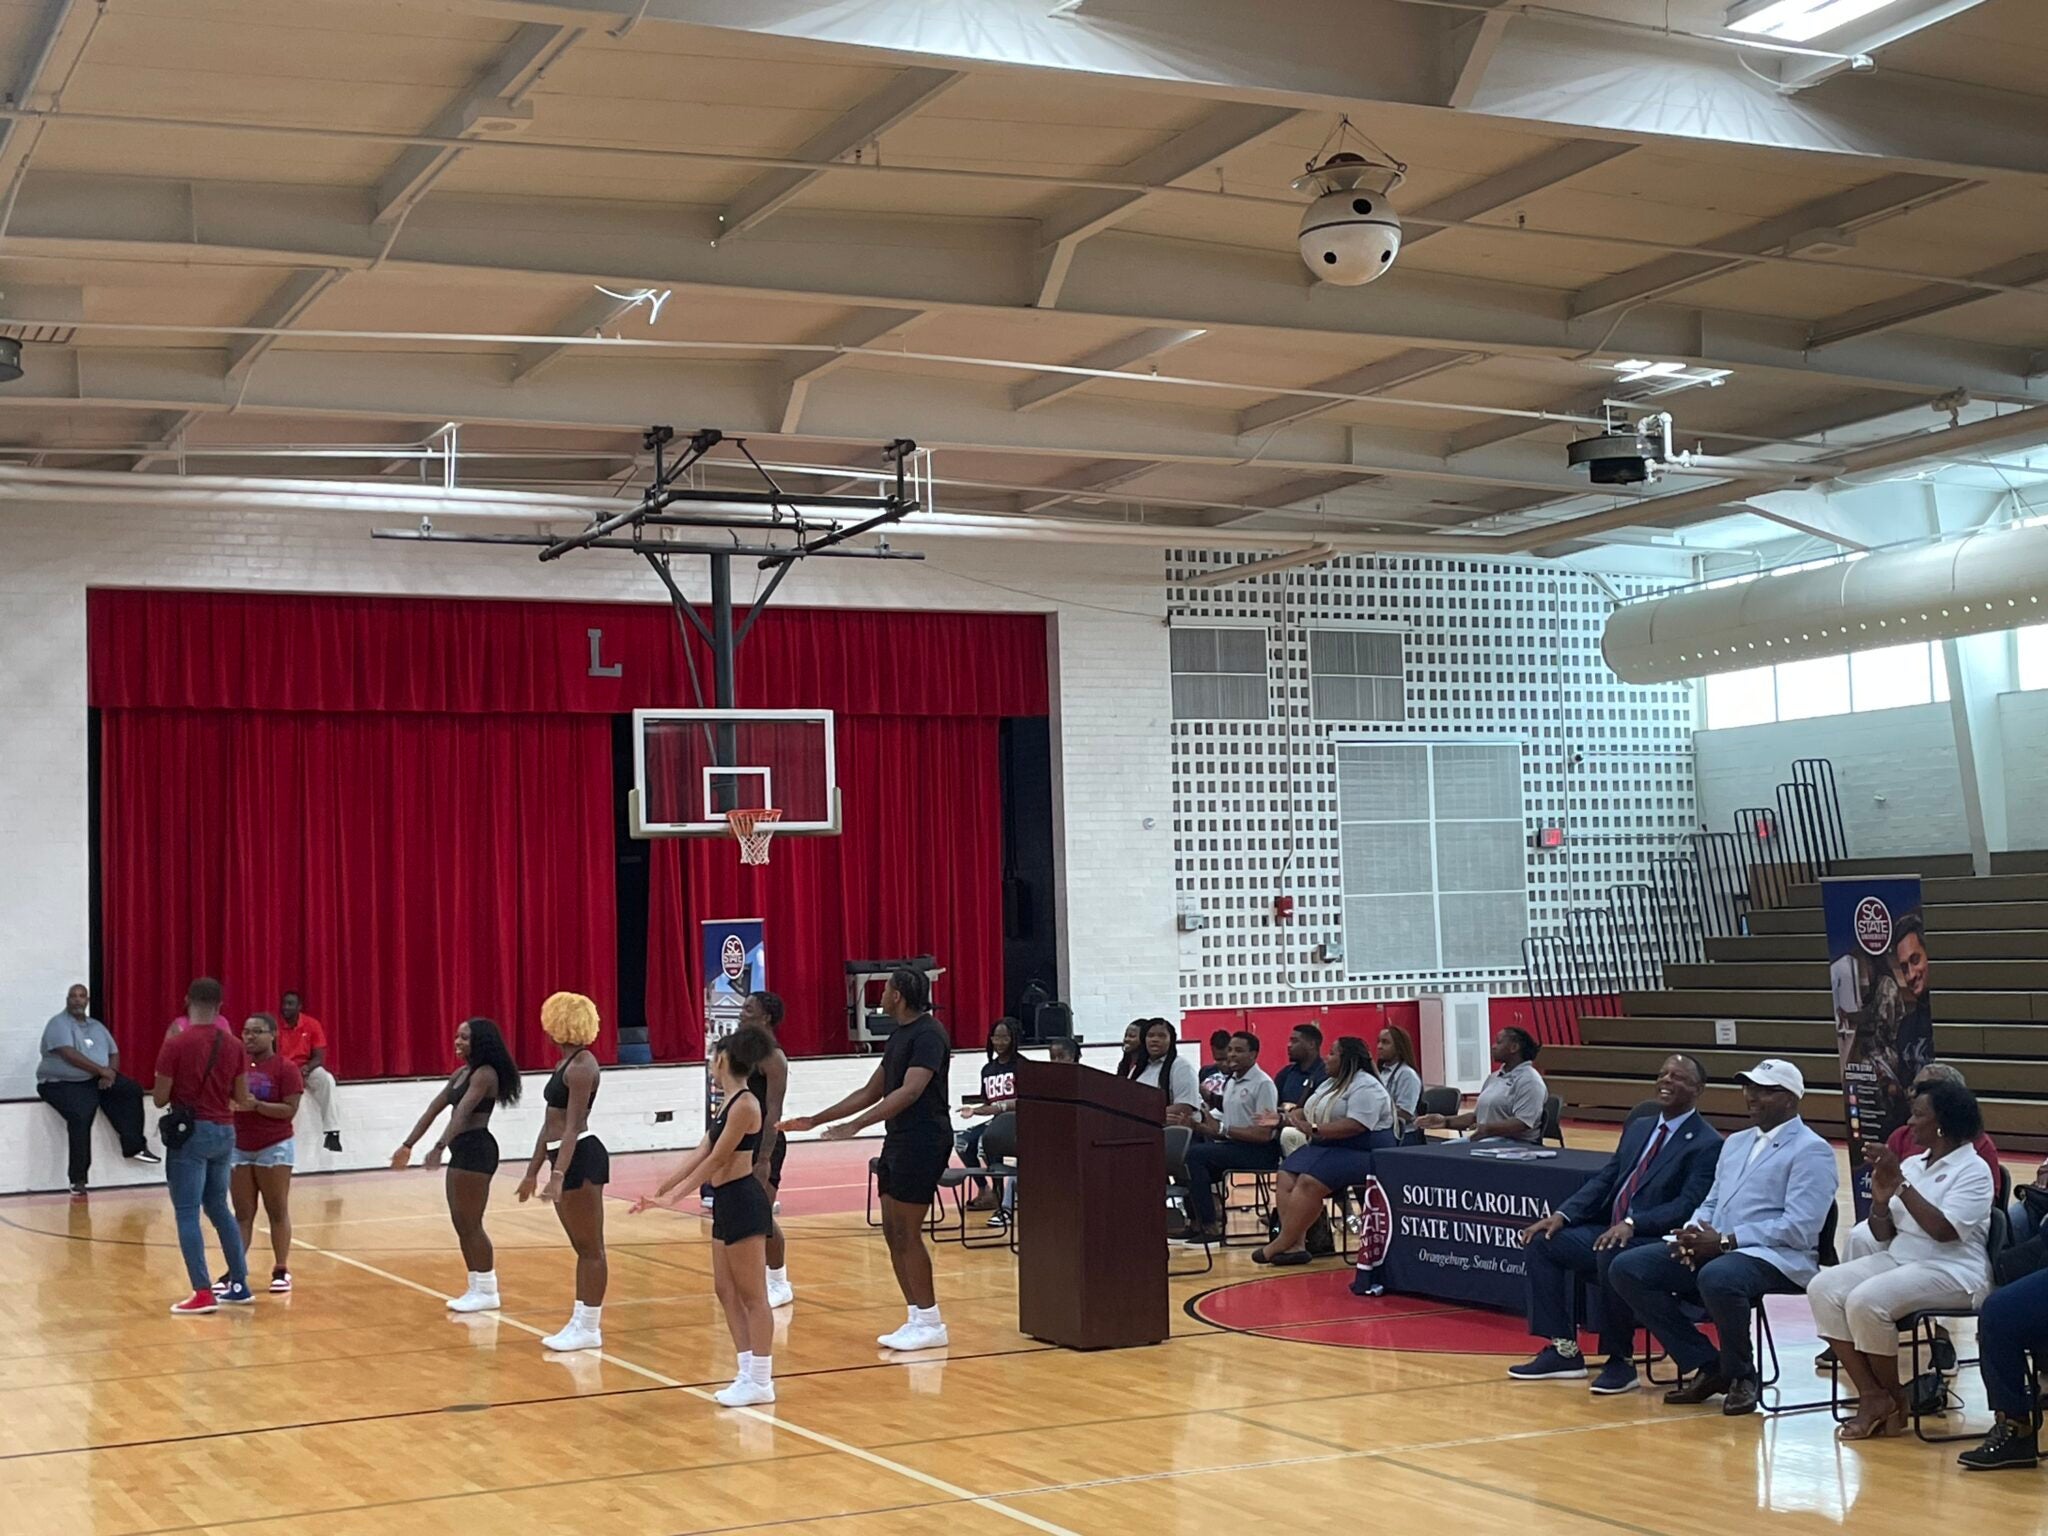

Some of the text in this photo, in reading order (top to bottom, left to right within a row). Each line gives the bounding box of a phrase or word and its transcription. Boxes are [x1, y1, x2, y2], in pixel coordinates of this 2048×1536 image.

[587, 628, 623, 677] L
[1862, 904, 1882, 920] SC
[1858, 920, 1888, 934] STATE
[1403, 1184, 1551, 1219] SOUTH CAROLINA
[1401, 1215, 1450, 1240] STATE
[1453, 1221, 1525, 1250] UNIVERS
[1473, 1254, 1498, 1272] South
